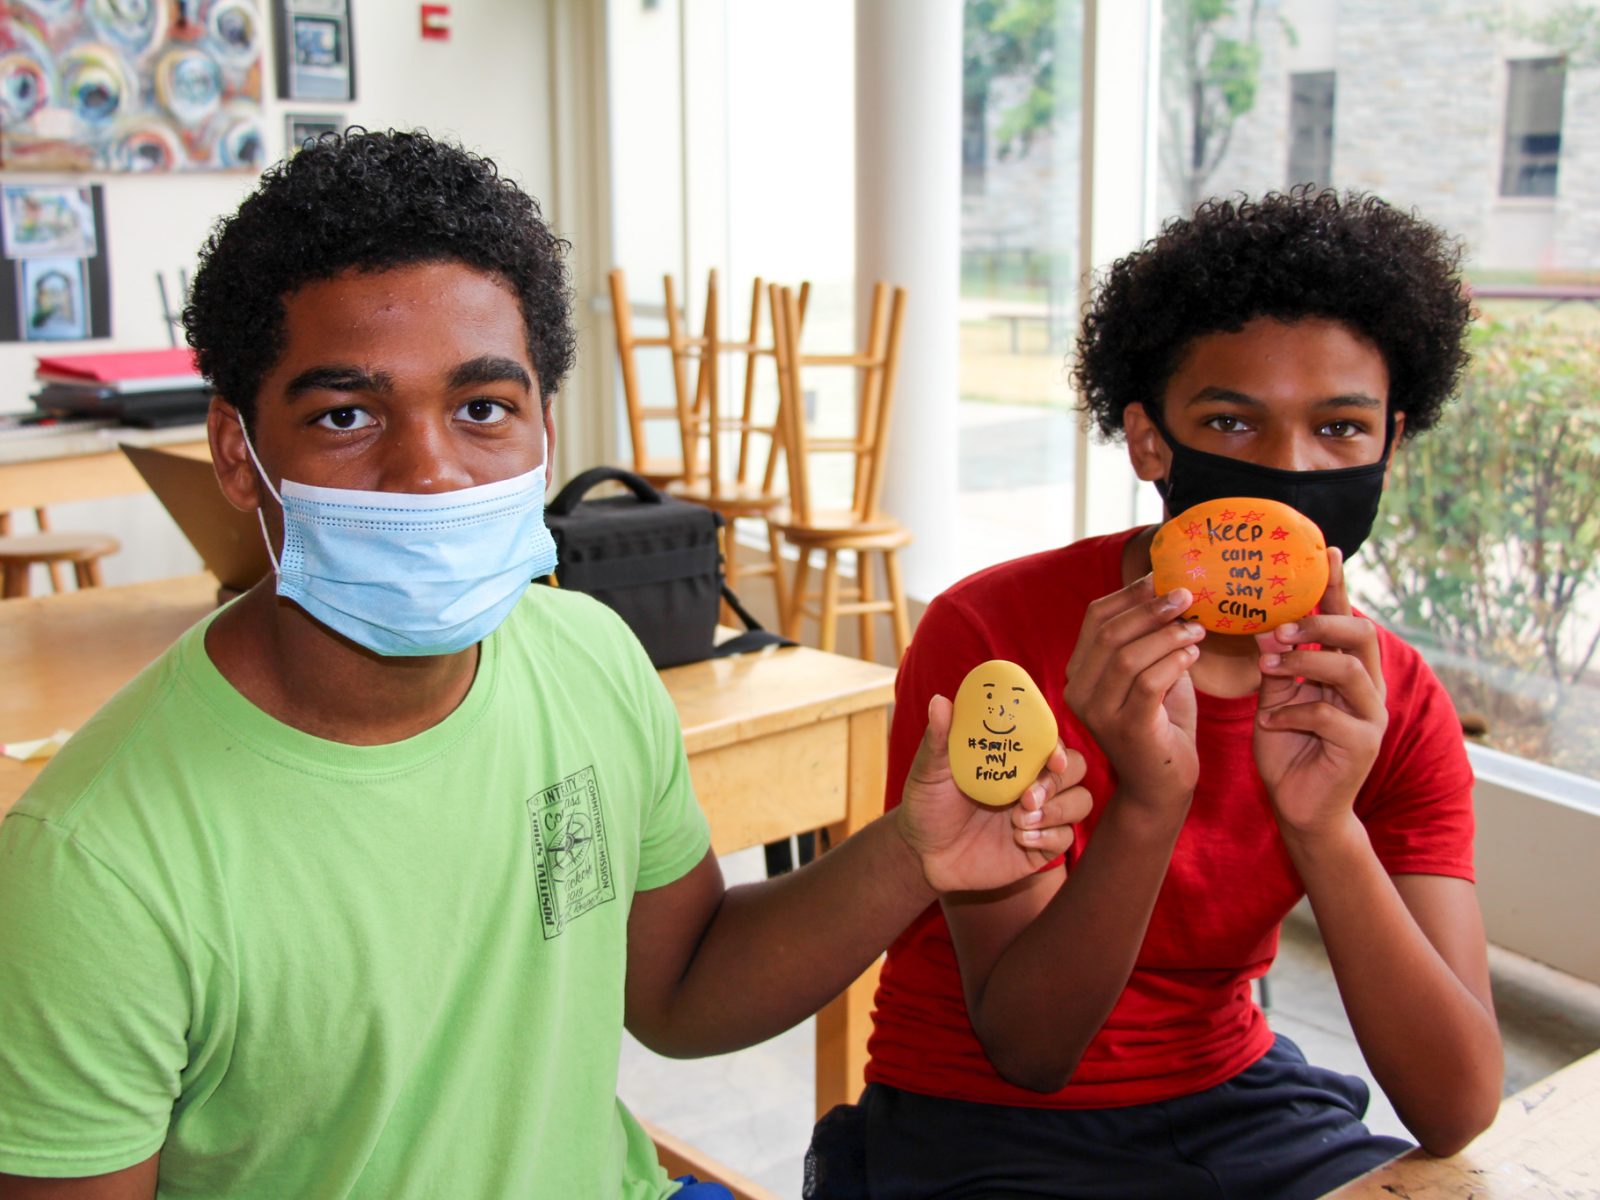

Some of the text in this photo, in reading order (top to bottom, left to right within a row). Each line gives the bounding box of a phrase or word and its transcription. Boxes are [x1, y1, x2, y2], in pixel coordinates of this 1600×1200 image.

[1221, 548, 1263, 562] calm
[1229, 565, 1261, 581] and
[1217, 599, 1267, 623] calm
[985, 752, 1007, 767] my
[586, 779, 604, 847] COMMITMENT
[599, 850, 610, 889] MISSION
